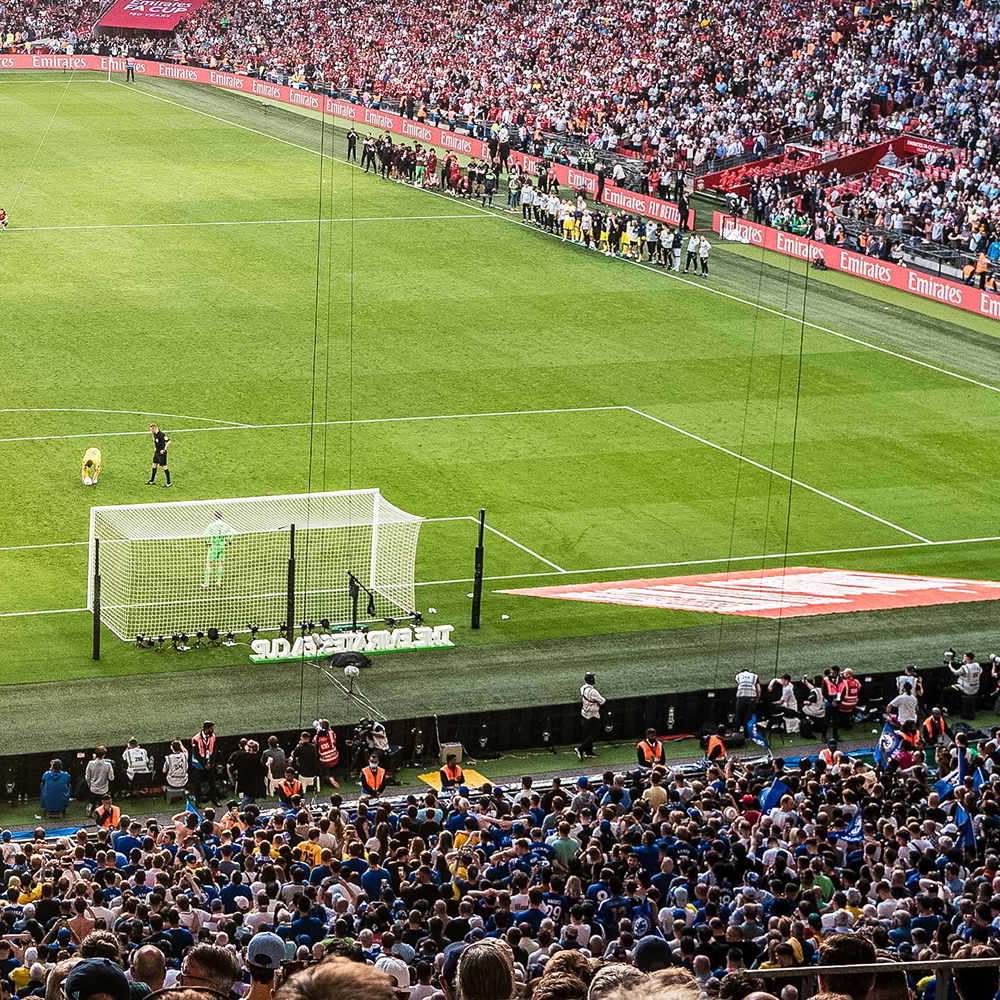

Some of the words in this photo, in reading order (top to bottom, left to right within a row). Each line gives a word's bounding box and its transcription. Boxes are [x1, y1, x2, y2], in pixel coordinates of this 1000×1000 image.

[32, 55, 86, 68] Emirates
[101, 58, 145, 73] Emires
[159, 64, 197, 80] Emirates
[210, 72, 243, 89] Emirates
[252, 81, 280, 99] Emirates
[289, 88, 318, 108] Emirates
[327, 100, 355, 118] Emirates
[365, 110, 393, 130] Emirates
[402, 120, 432, 141] Emirates
[441, 132, 472, 153] Emirates
[568, 170, 596, 191] Emirat
[604, 187, 645, 212] Emirates
[648, 200, 660, 215] FLY
[720, 216, 762, 244] Emirates
[776, 232, 824, 260] Emirates
[840, 251, 891, 282] Emirates
[908, 271, 962, 304] Emirates
[546, 904, 561, 921] 29
